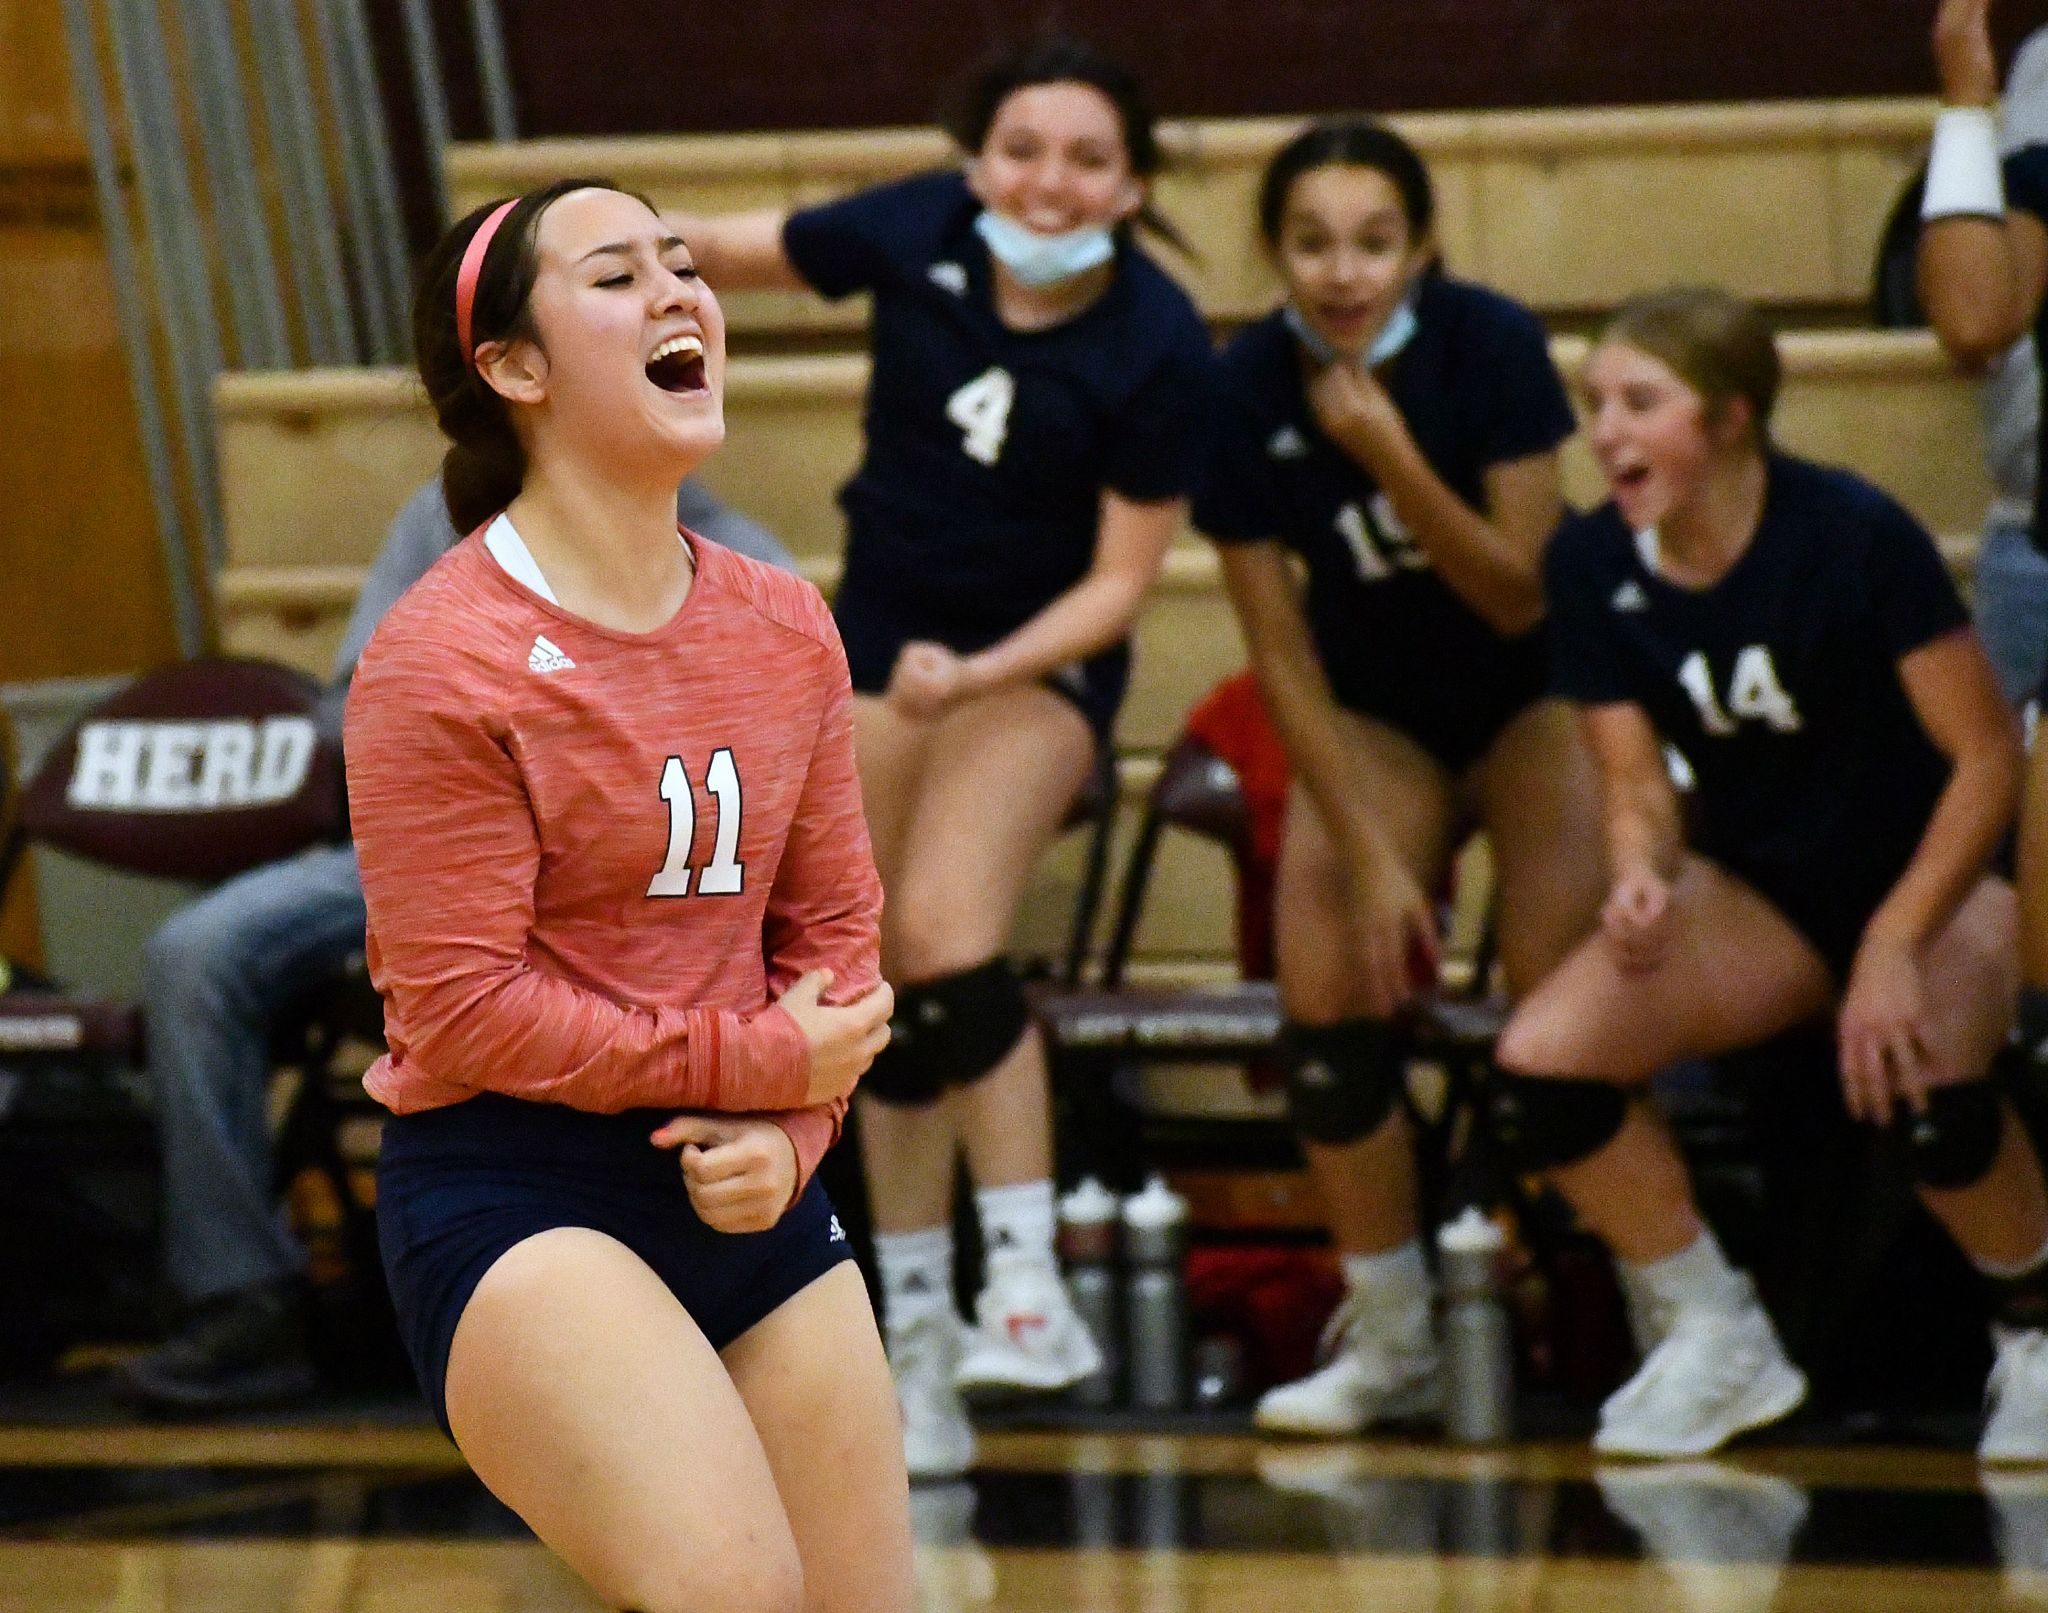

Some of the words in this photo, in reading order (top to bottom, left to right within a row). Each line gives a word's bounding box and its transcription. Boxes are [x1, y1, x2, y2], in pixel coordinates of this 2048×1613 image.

[945, 366, 1016, 466] 4
[1677, 644, 1803, 735] 14
[66, 716, 316, 813] HERD
[645, 746, 745, 899] 11
